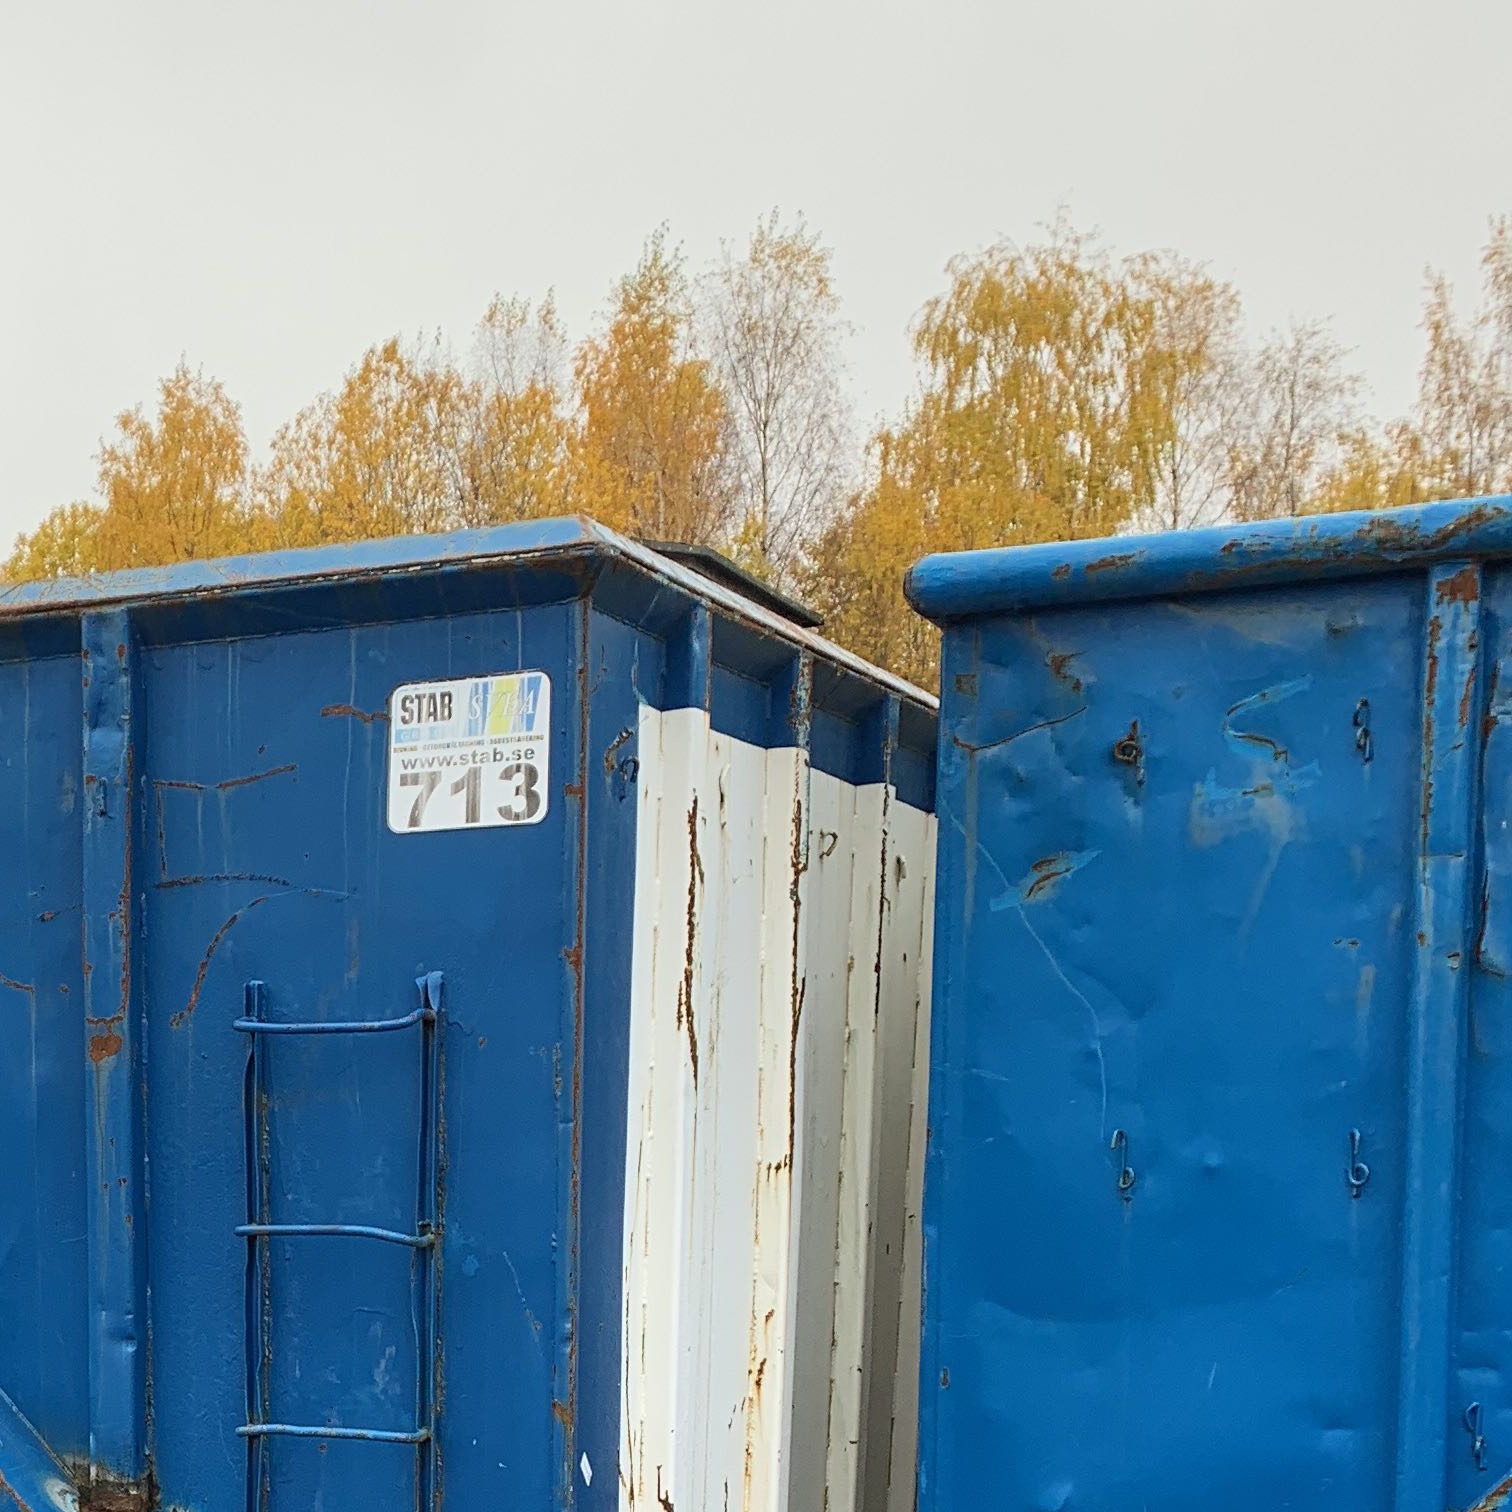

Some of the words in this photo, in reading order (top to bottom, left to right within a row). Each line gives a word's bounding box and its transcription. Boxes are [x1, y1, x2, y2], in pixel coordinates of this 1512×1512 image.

[400, 690, 453, 725] STAB
[401, 747, 536, 771] www.stab.se
[399, 762, 541, 828] 713
